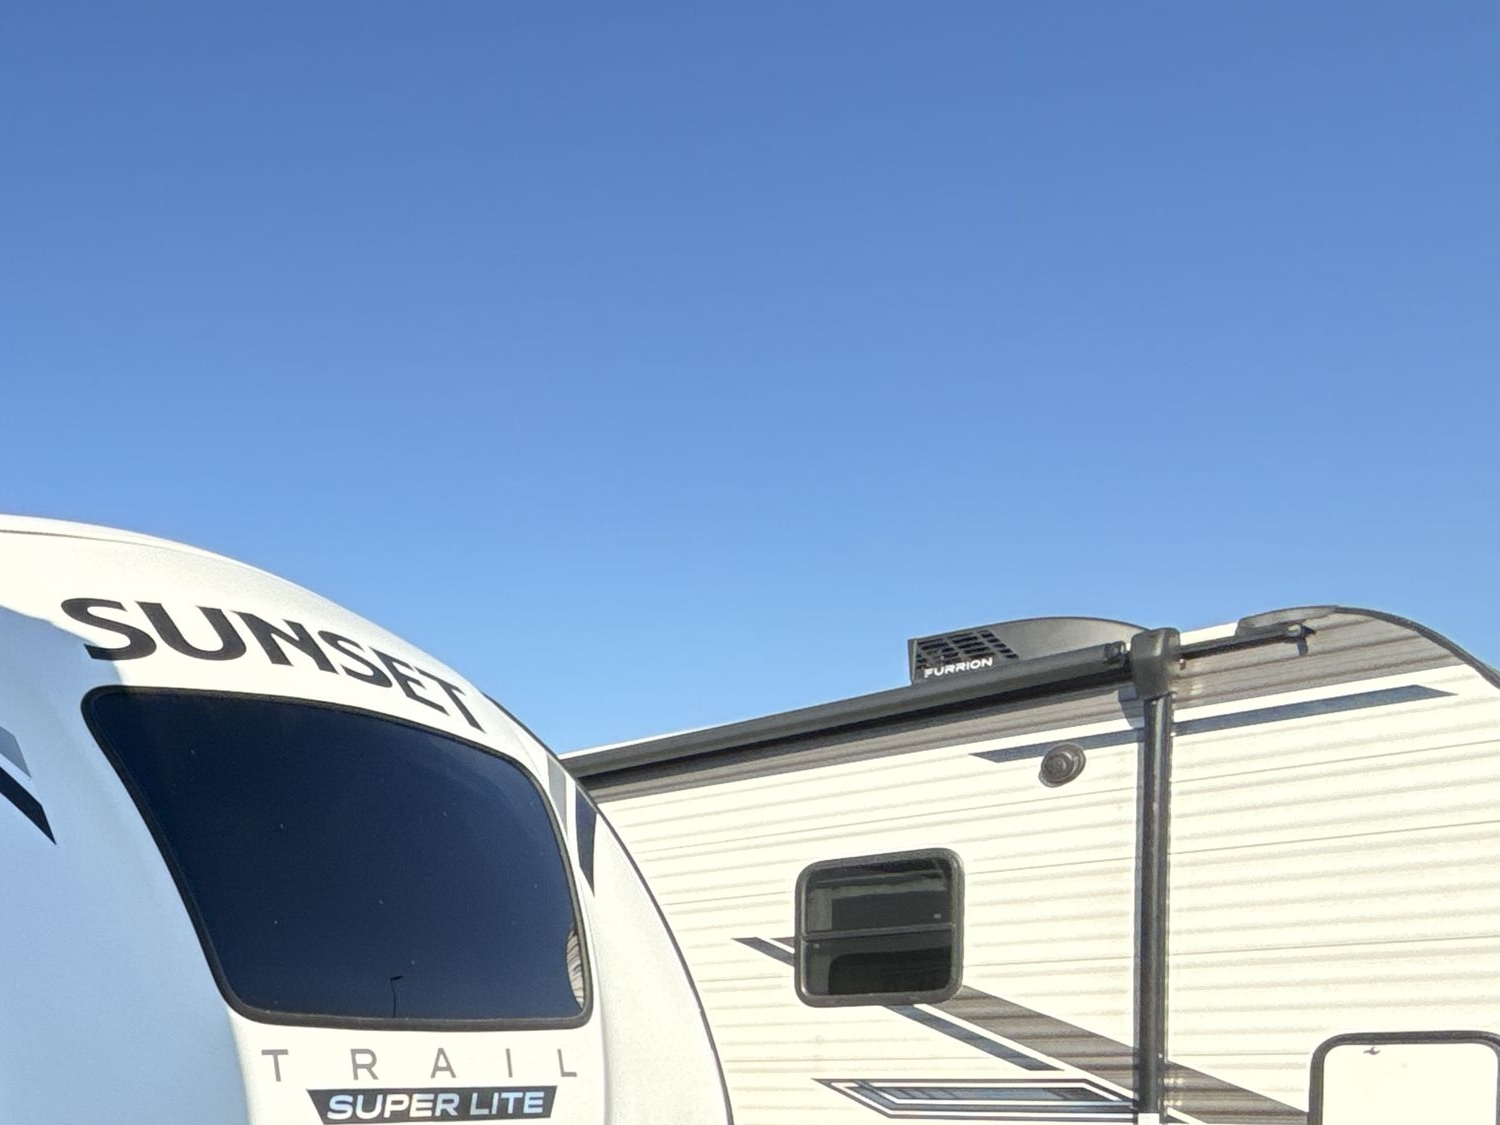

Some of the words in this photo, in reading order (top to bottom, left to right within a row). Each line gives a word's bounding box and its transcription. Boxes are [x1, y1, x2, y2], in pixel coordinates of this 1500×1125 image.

[60, 597, 487, 734] SUNSET
[923, 657, 994, 679] FURRION
[261, 1047, 578, 1083] TRAIL
[326, 1093, 460, 1120] SUPER
[468, 1091, 545, 1117] LITE
